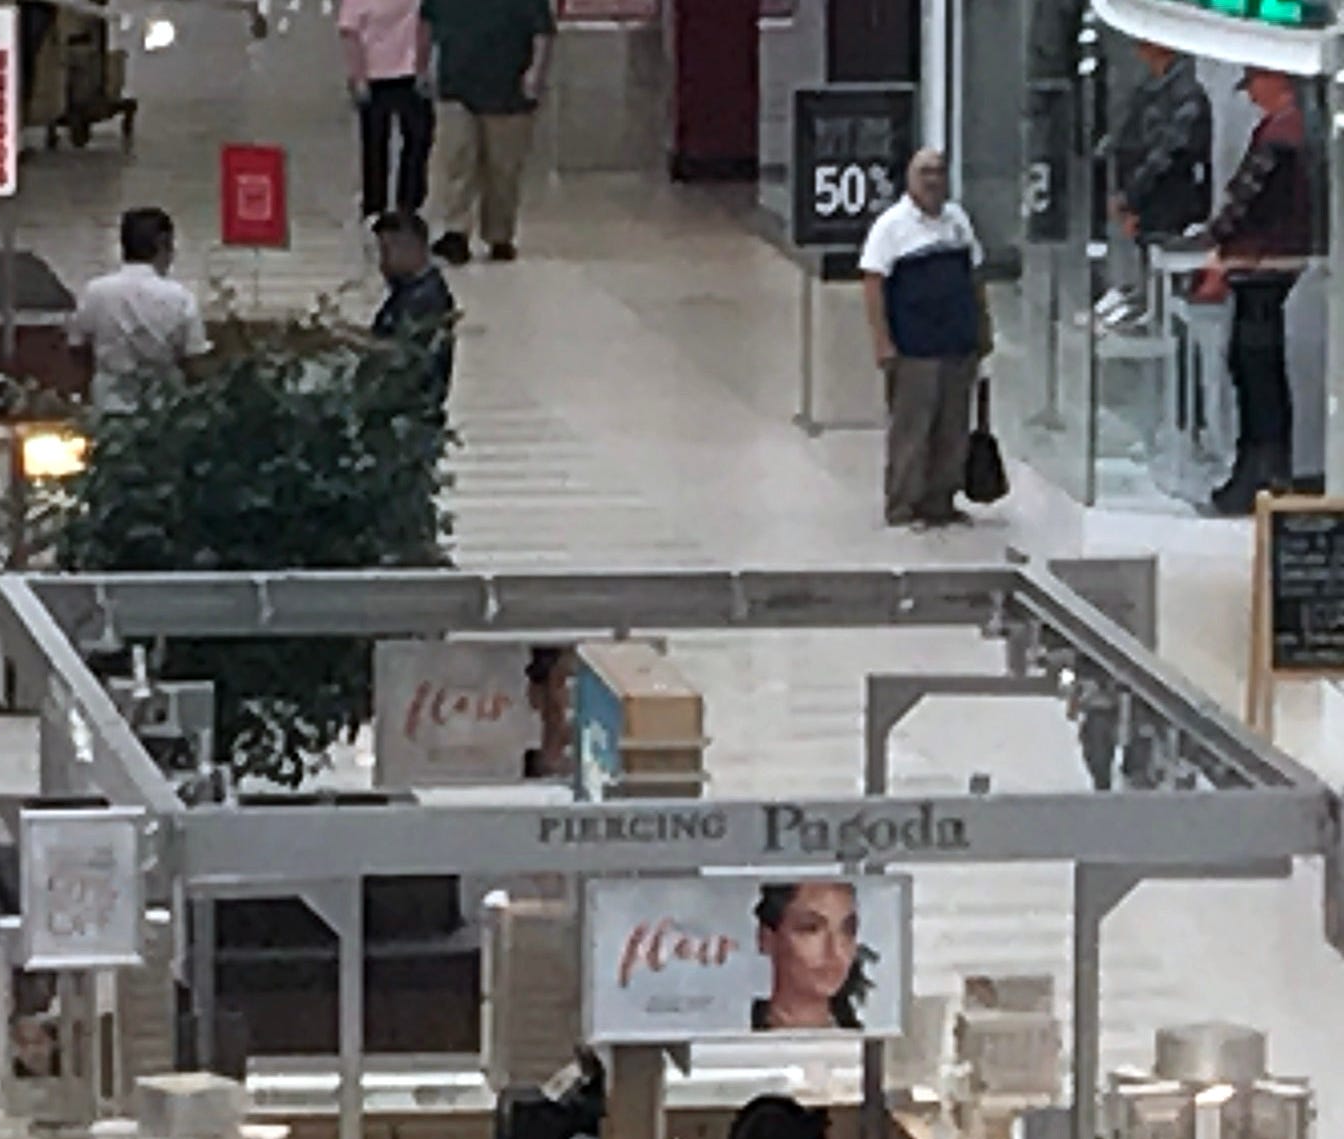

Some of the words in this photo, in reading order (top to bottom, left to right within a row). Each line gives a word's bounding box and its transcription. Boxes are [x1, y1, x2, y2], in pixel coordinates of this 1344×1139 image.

[537, 809, 728, 844] PIERCING
[760, 801, 970, 860] Pagoda
[617, 915, 739, 988] flair
